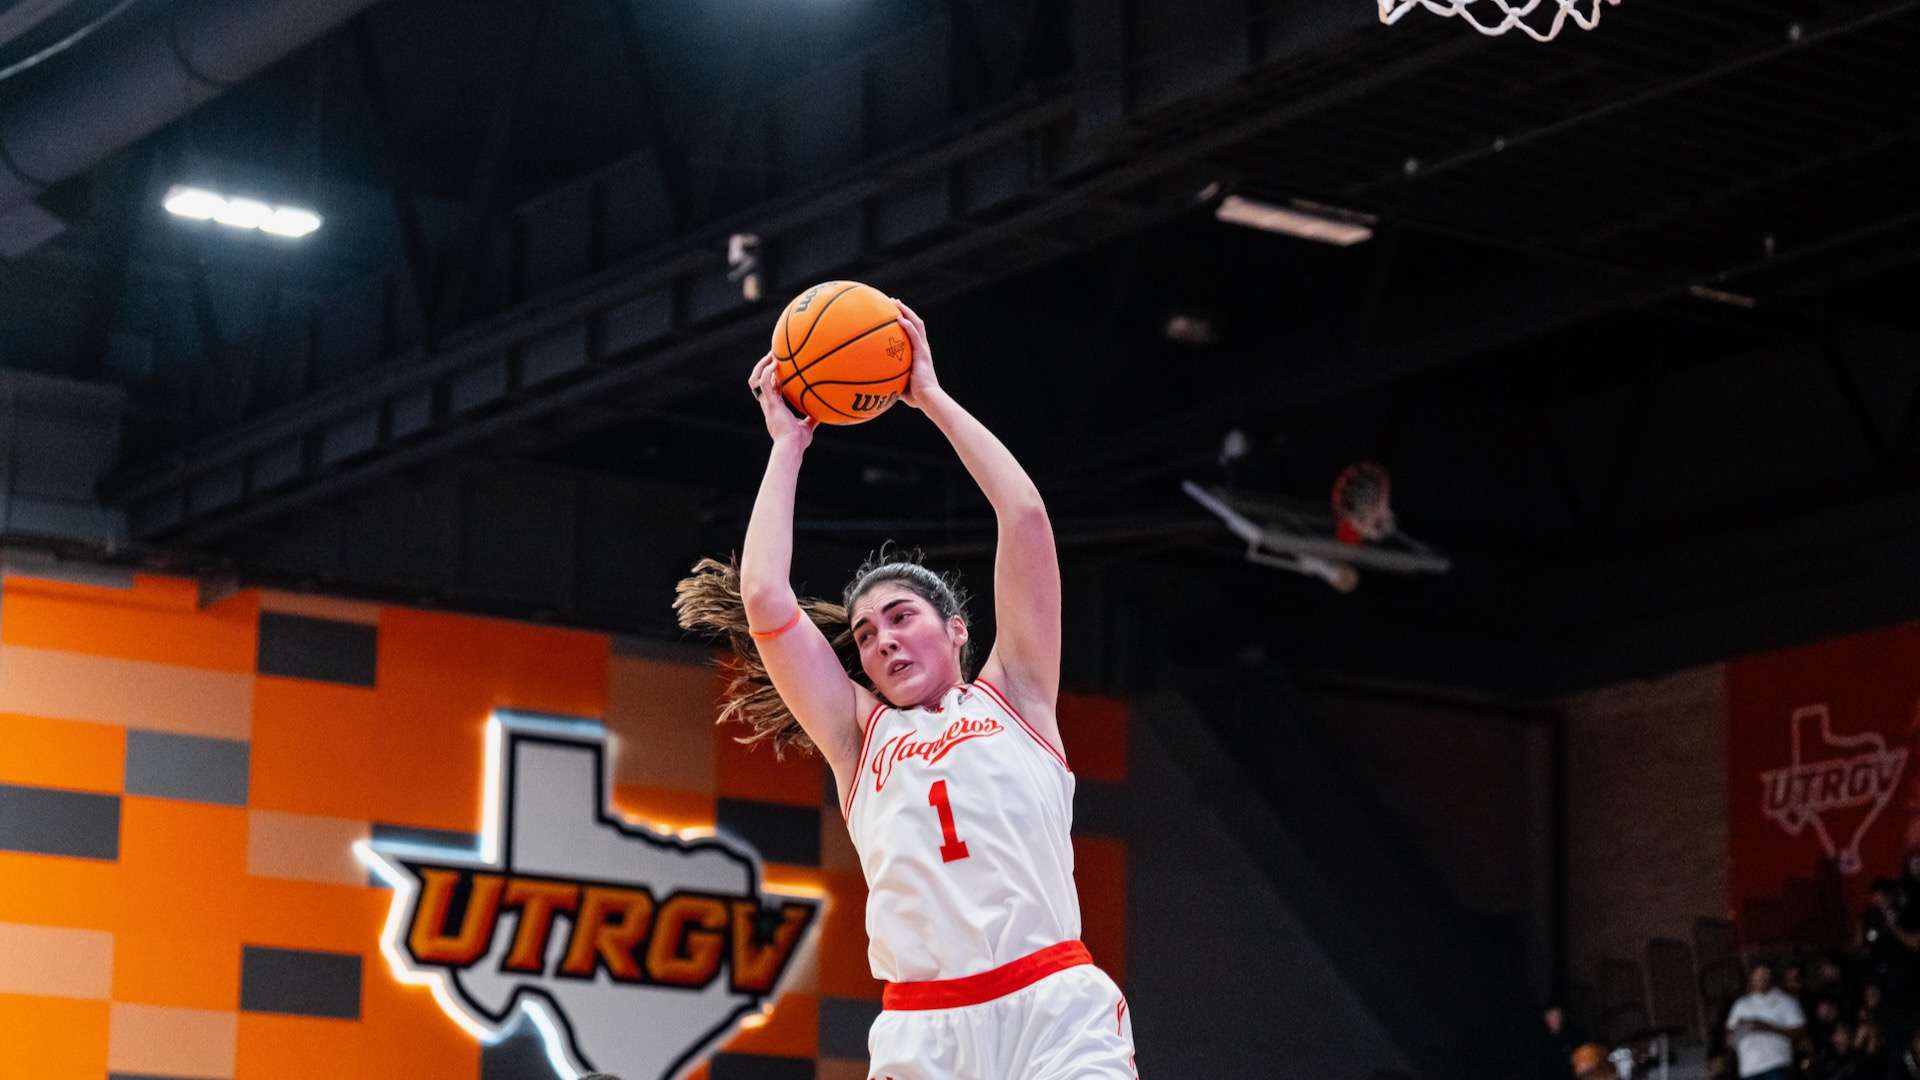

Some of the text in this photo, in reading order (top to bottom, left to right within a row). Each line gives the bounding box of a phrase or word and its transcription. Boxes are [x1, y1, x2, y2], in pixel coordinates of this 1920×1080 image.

[852, 391, 898, 411] Wil
[872, 717, 1004, 792] Vaqueros
[928, 779, 970, 863] 1
[406, 867, 810, 992] UTRGV
